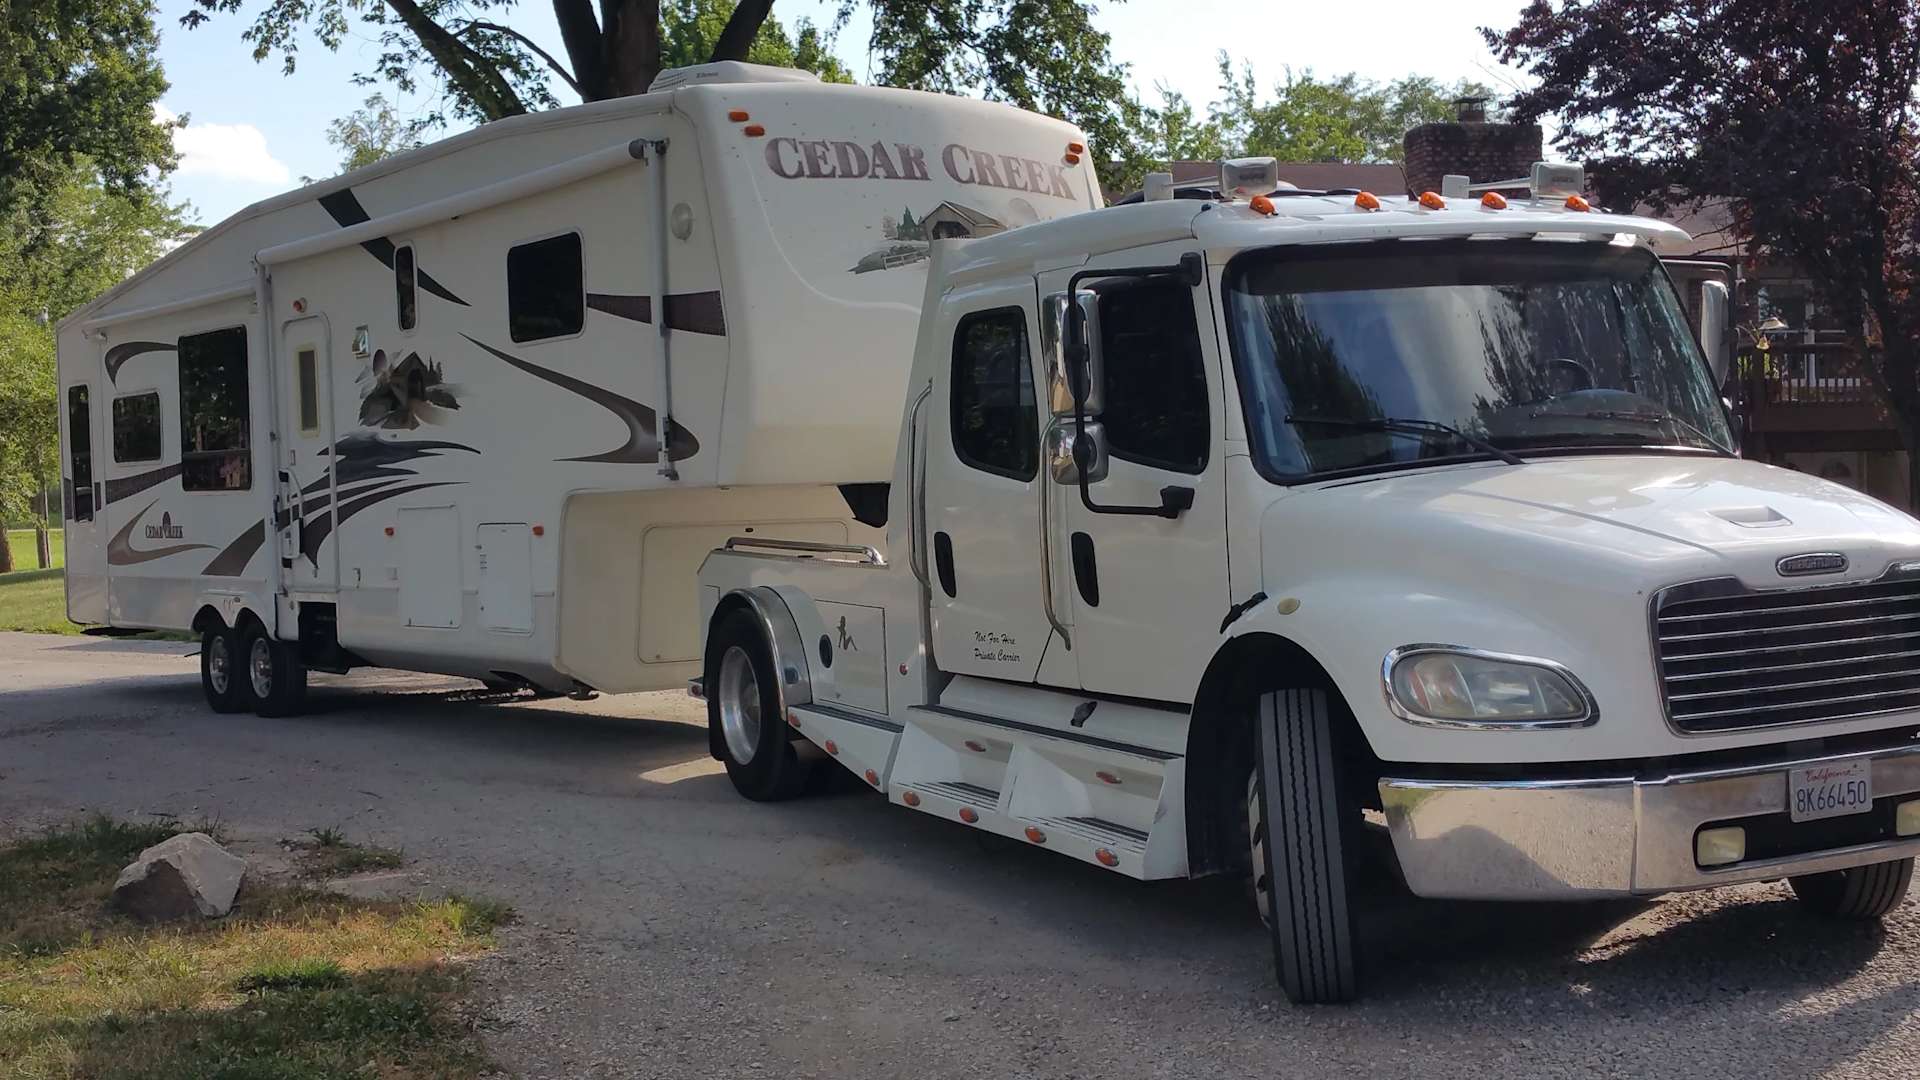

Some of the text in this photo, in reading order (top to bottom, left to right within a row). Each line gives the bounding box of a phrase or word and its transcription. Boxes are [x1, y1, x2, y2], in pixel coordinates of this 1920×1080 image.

[765, 137, 1075, 199] CEDAR CREEK
[145, 525, 163, 538] CEDAR
[974, 631, 986, 642] Not
[987, 632, 1000, 644] For
[974, 647, 1020, 662] Private Carrier
[1806, 768, 1851, 783] California
[1797, 780, 1867, 813] 8K66450
